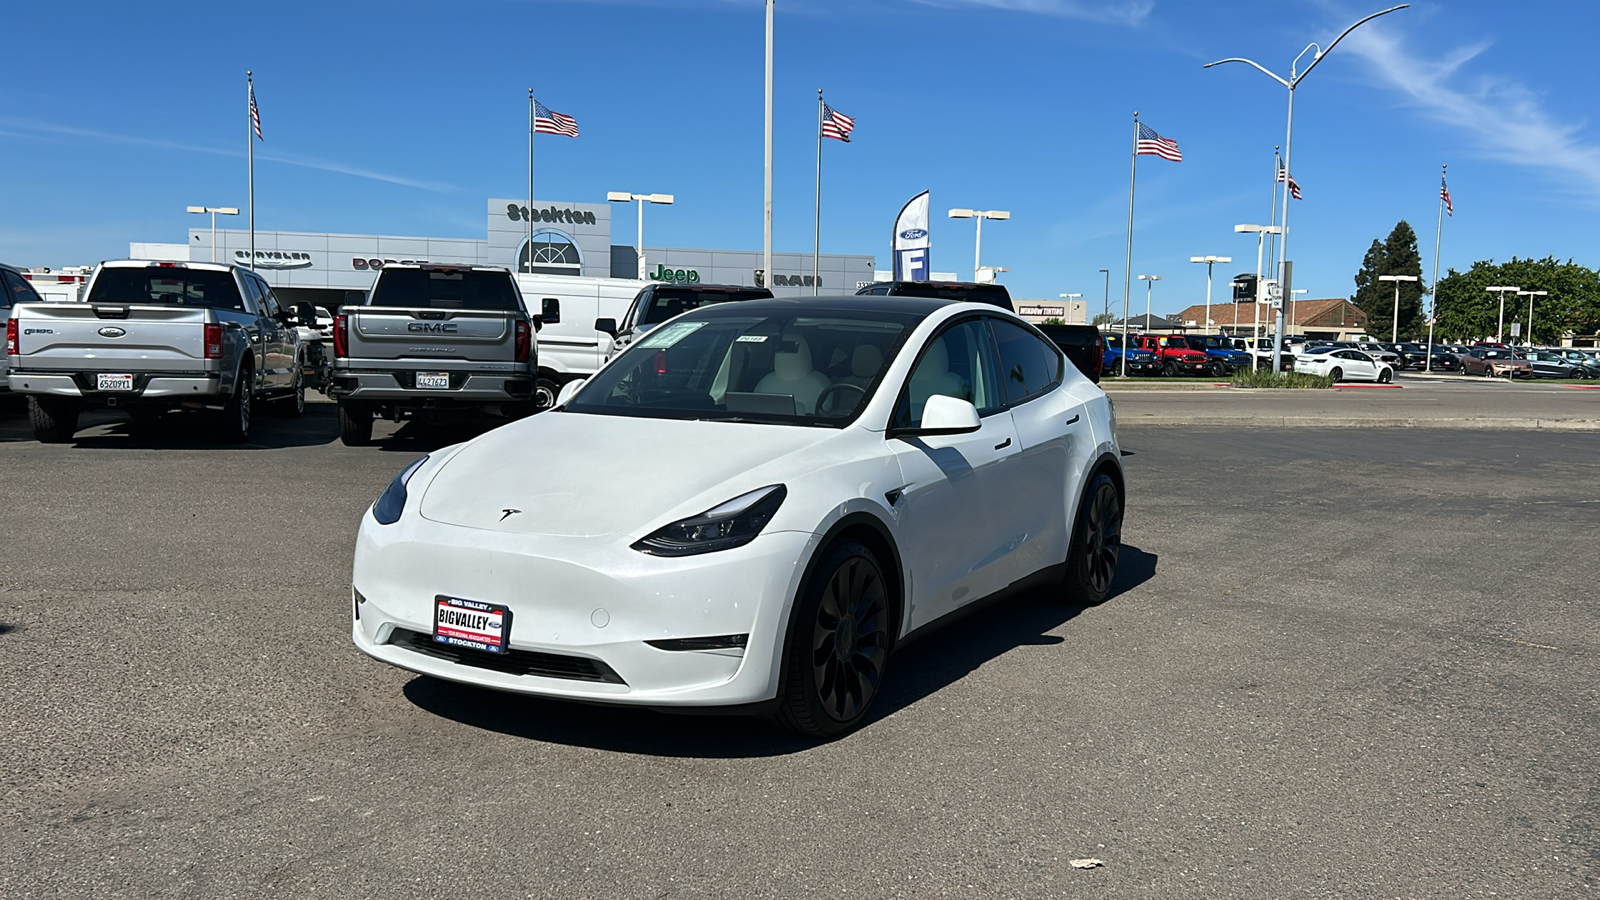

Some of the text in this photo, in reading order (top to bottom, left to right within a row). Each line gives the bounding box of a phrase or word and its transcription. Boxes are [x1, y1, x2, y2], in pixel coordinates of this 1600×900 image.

[507, 203, 596, 225] Stockton
[903, 229, 924, 239] Ford
[235, 250, 311, 260] CHRYSLER
[649, 264, 699, 283] Jeep
[773, 274, 822, 287] RAM
[407, 322, 458, 333] GMC
[99, 380, 130, 388] 65209Y1
[464, 601, 488, 610] VALLEY
[439, 609, 489, 631] BIGVALLEY
[448, 638, 487, 650] STOCKTON
